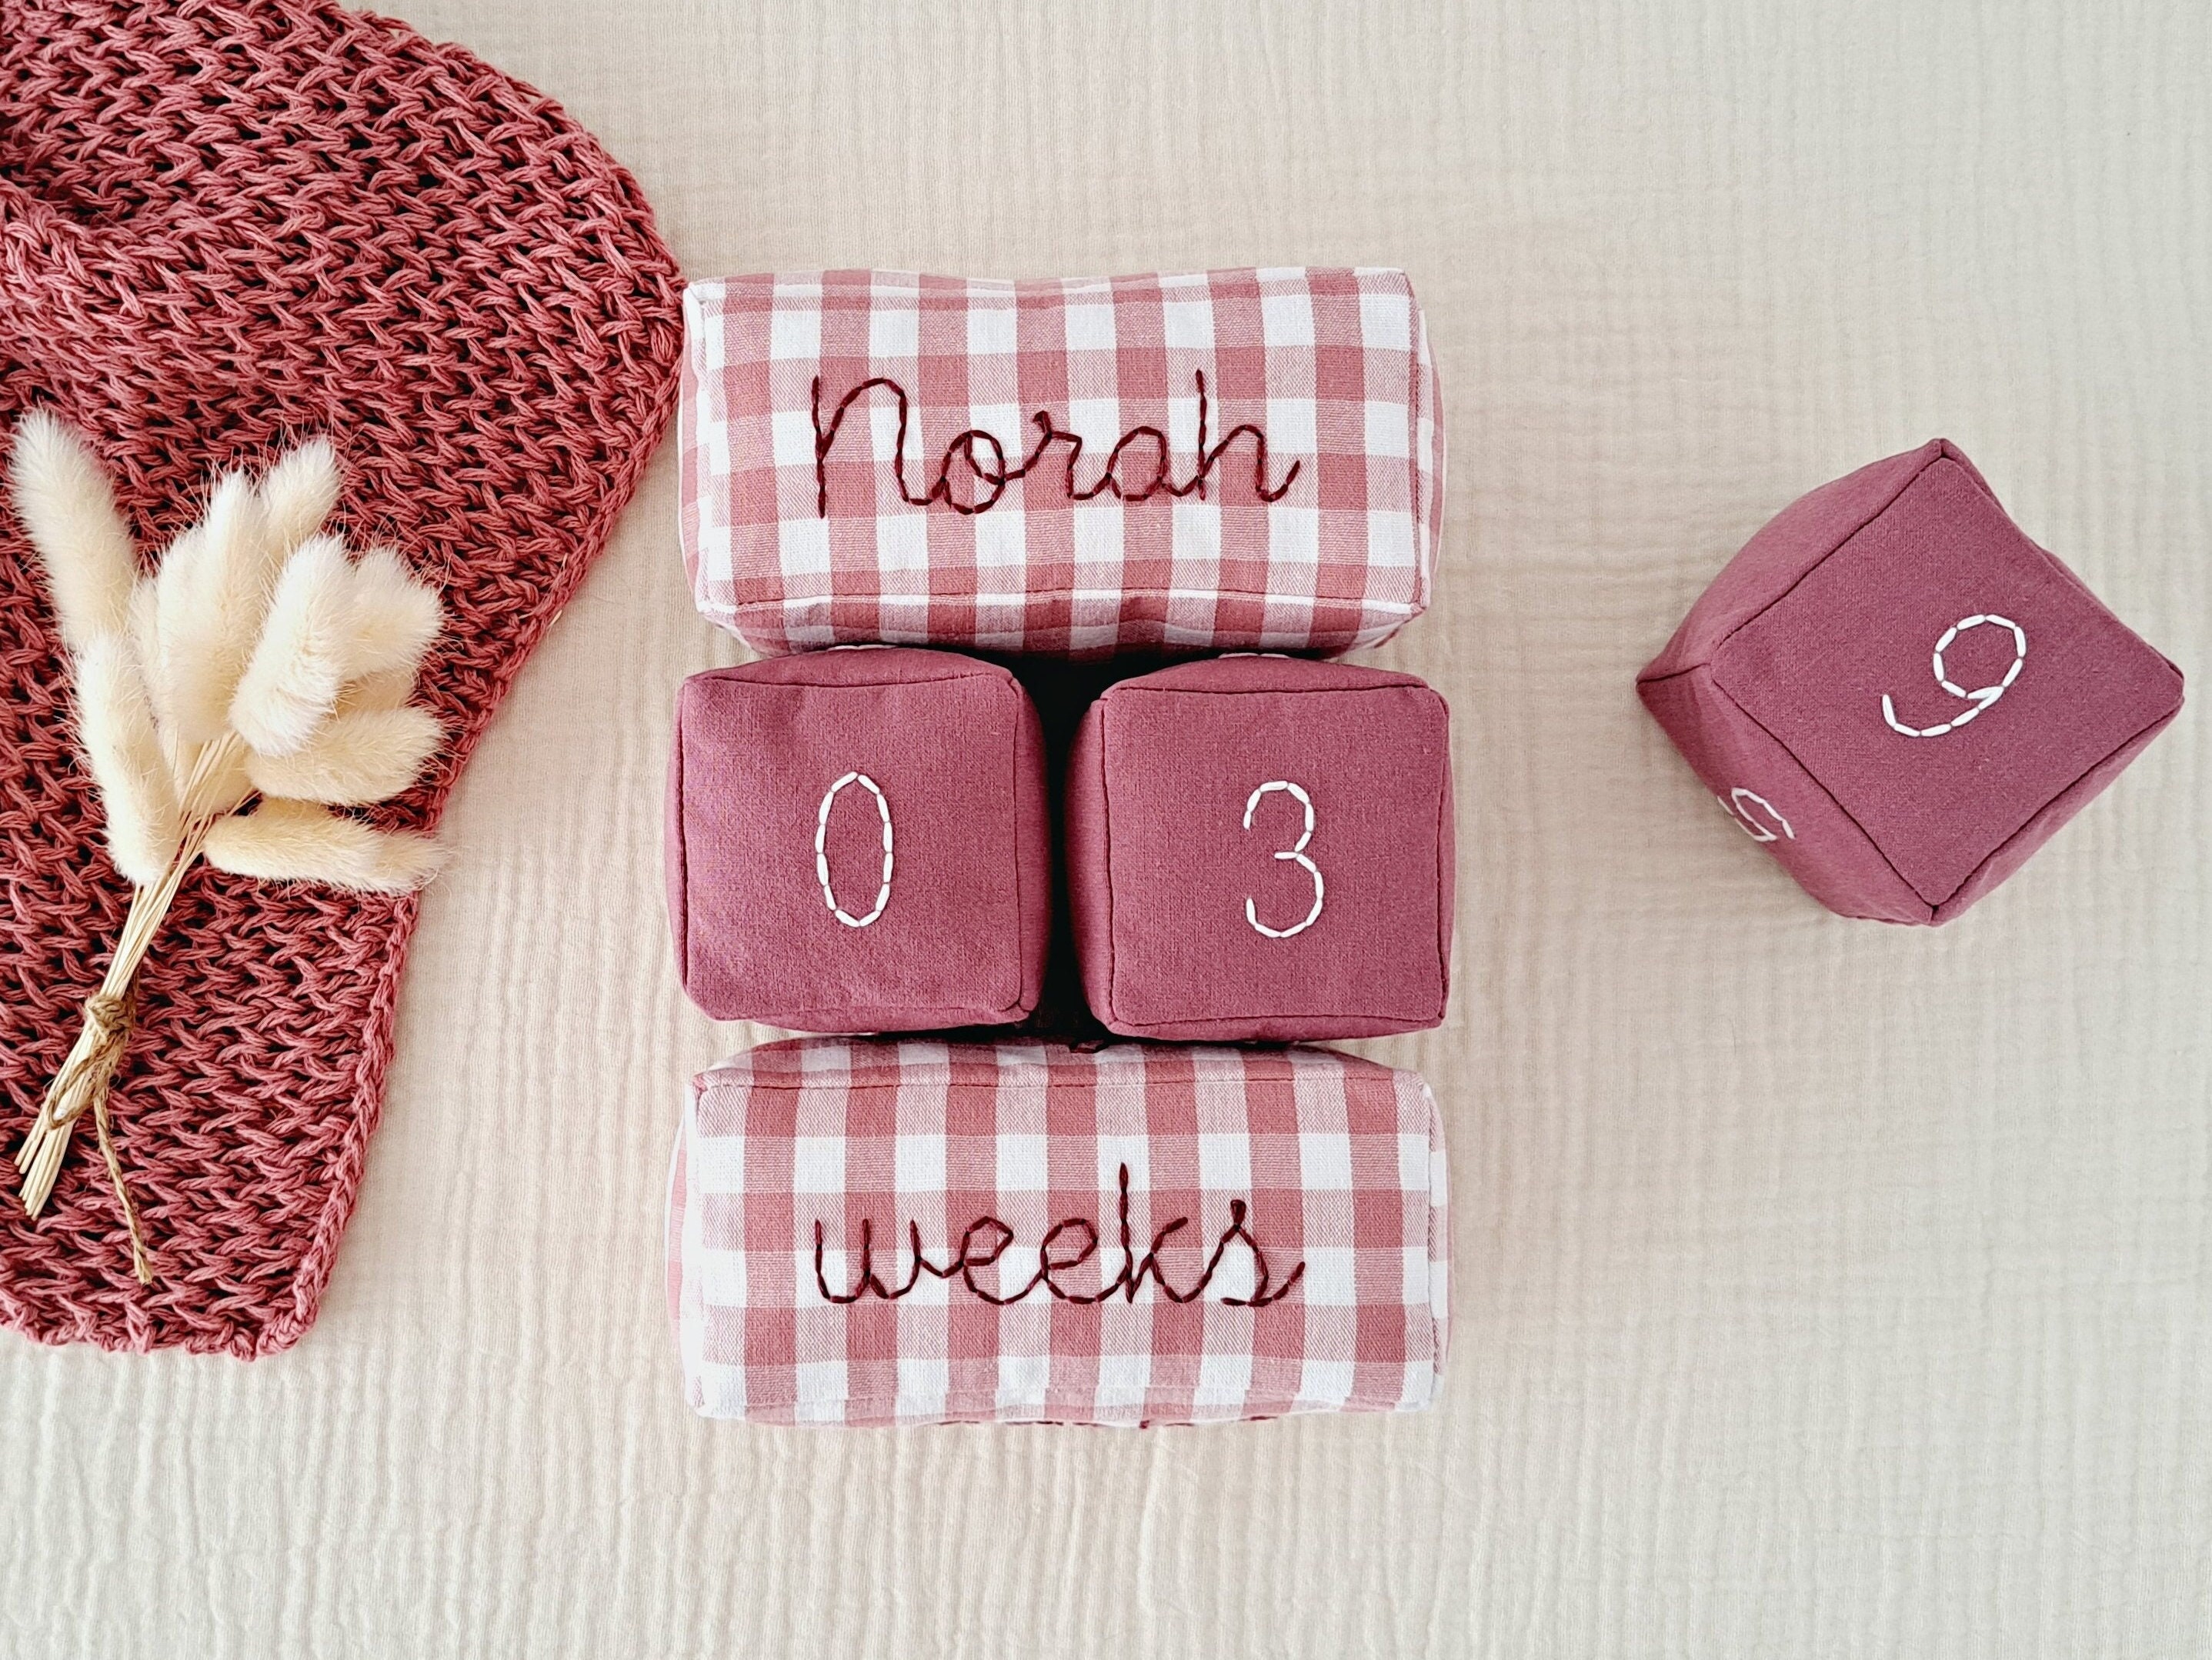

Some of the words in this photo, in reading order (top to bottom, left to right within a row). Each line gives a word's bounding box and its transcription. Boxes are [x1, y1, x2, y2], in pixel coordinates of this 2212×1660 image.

[810, 368, 1302, 520] Norah
[814, 771, 894, 928] 0
[1242, 779, 1325, 938] 3
[813, 1161, 1307, 1309] weeks
